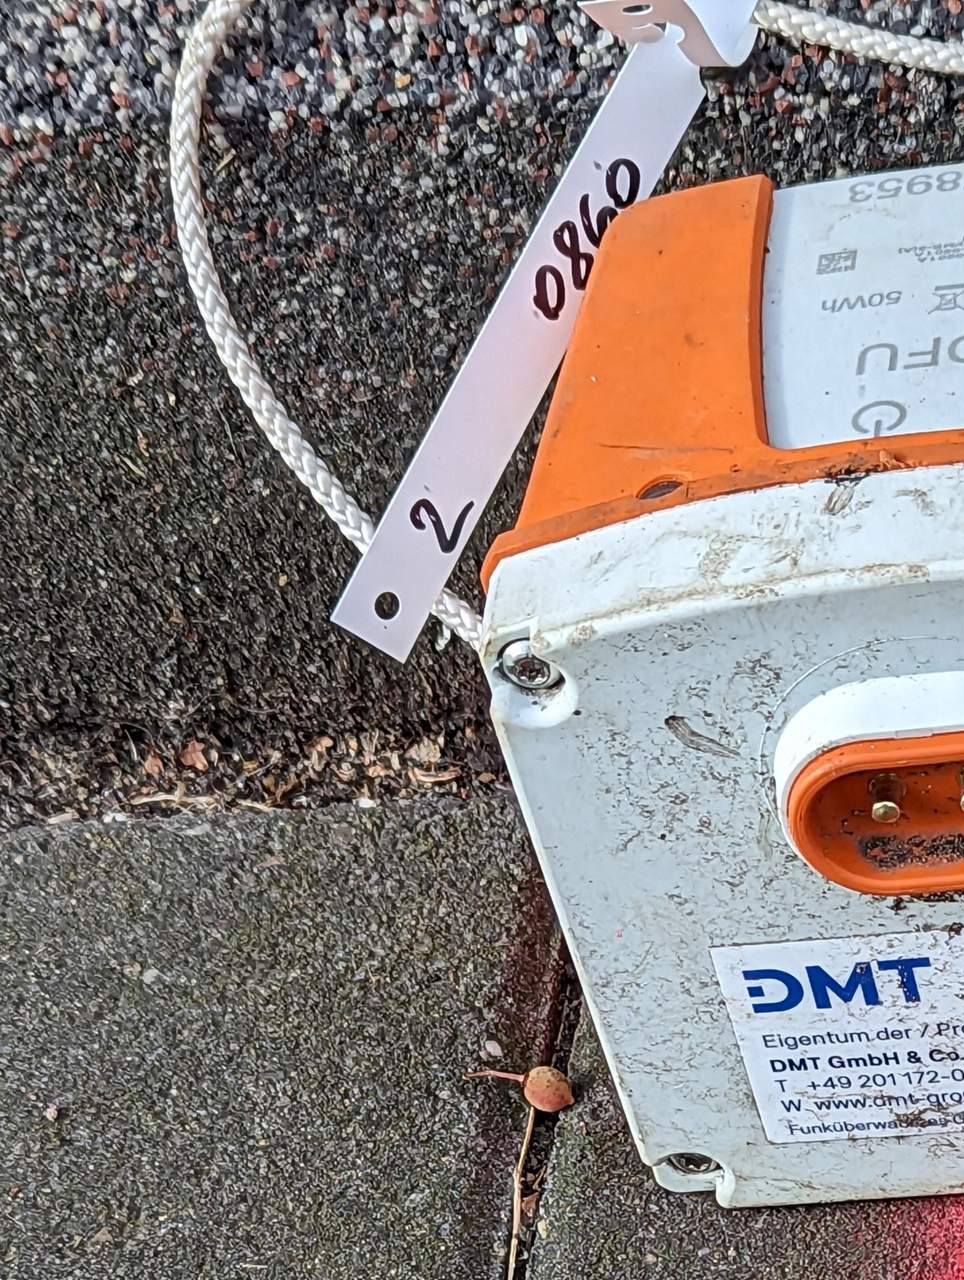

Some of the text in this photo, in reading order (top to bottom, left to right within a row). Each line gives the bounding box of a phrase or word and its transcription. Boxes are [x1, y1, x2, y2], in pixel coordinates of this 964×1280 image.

[821, 290, 903, 313] 50Wh
[410, 498, 475, 554] 2
[742, 957, 931, 1014] DMT
[761, 1029, 870, 1050] Eigentum
[876, 1026, 911, 1042] der
[919, 1024, 929, 1039] /
[769, 1056, 821, 1073] DMT
[828, 1051, 900, 1070] GmbH
[907, 1050, 922, 1064] &
[774, 1079, 788, 1093] T
[807, 1075, 852, 1091] +49
[858, 1072, 897, 1089] 201
[780, 1099, 802, 1113] W
